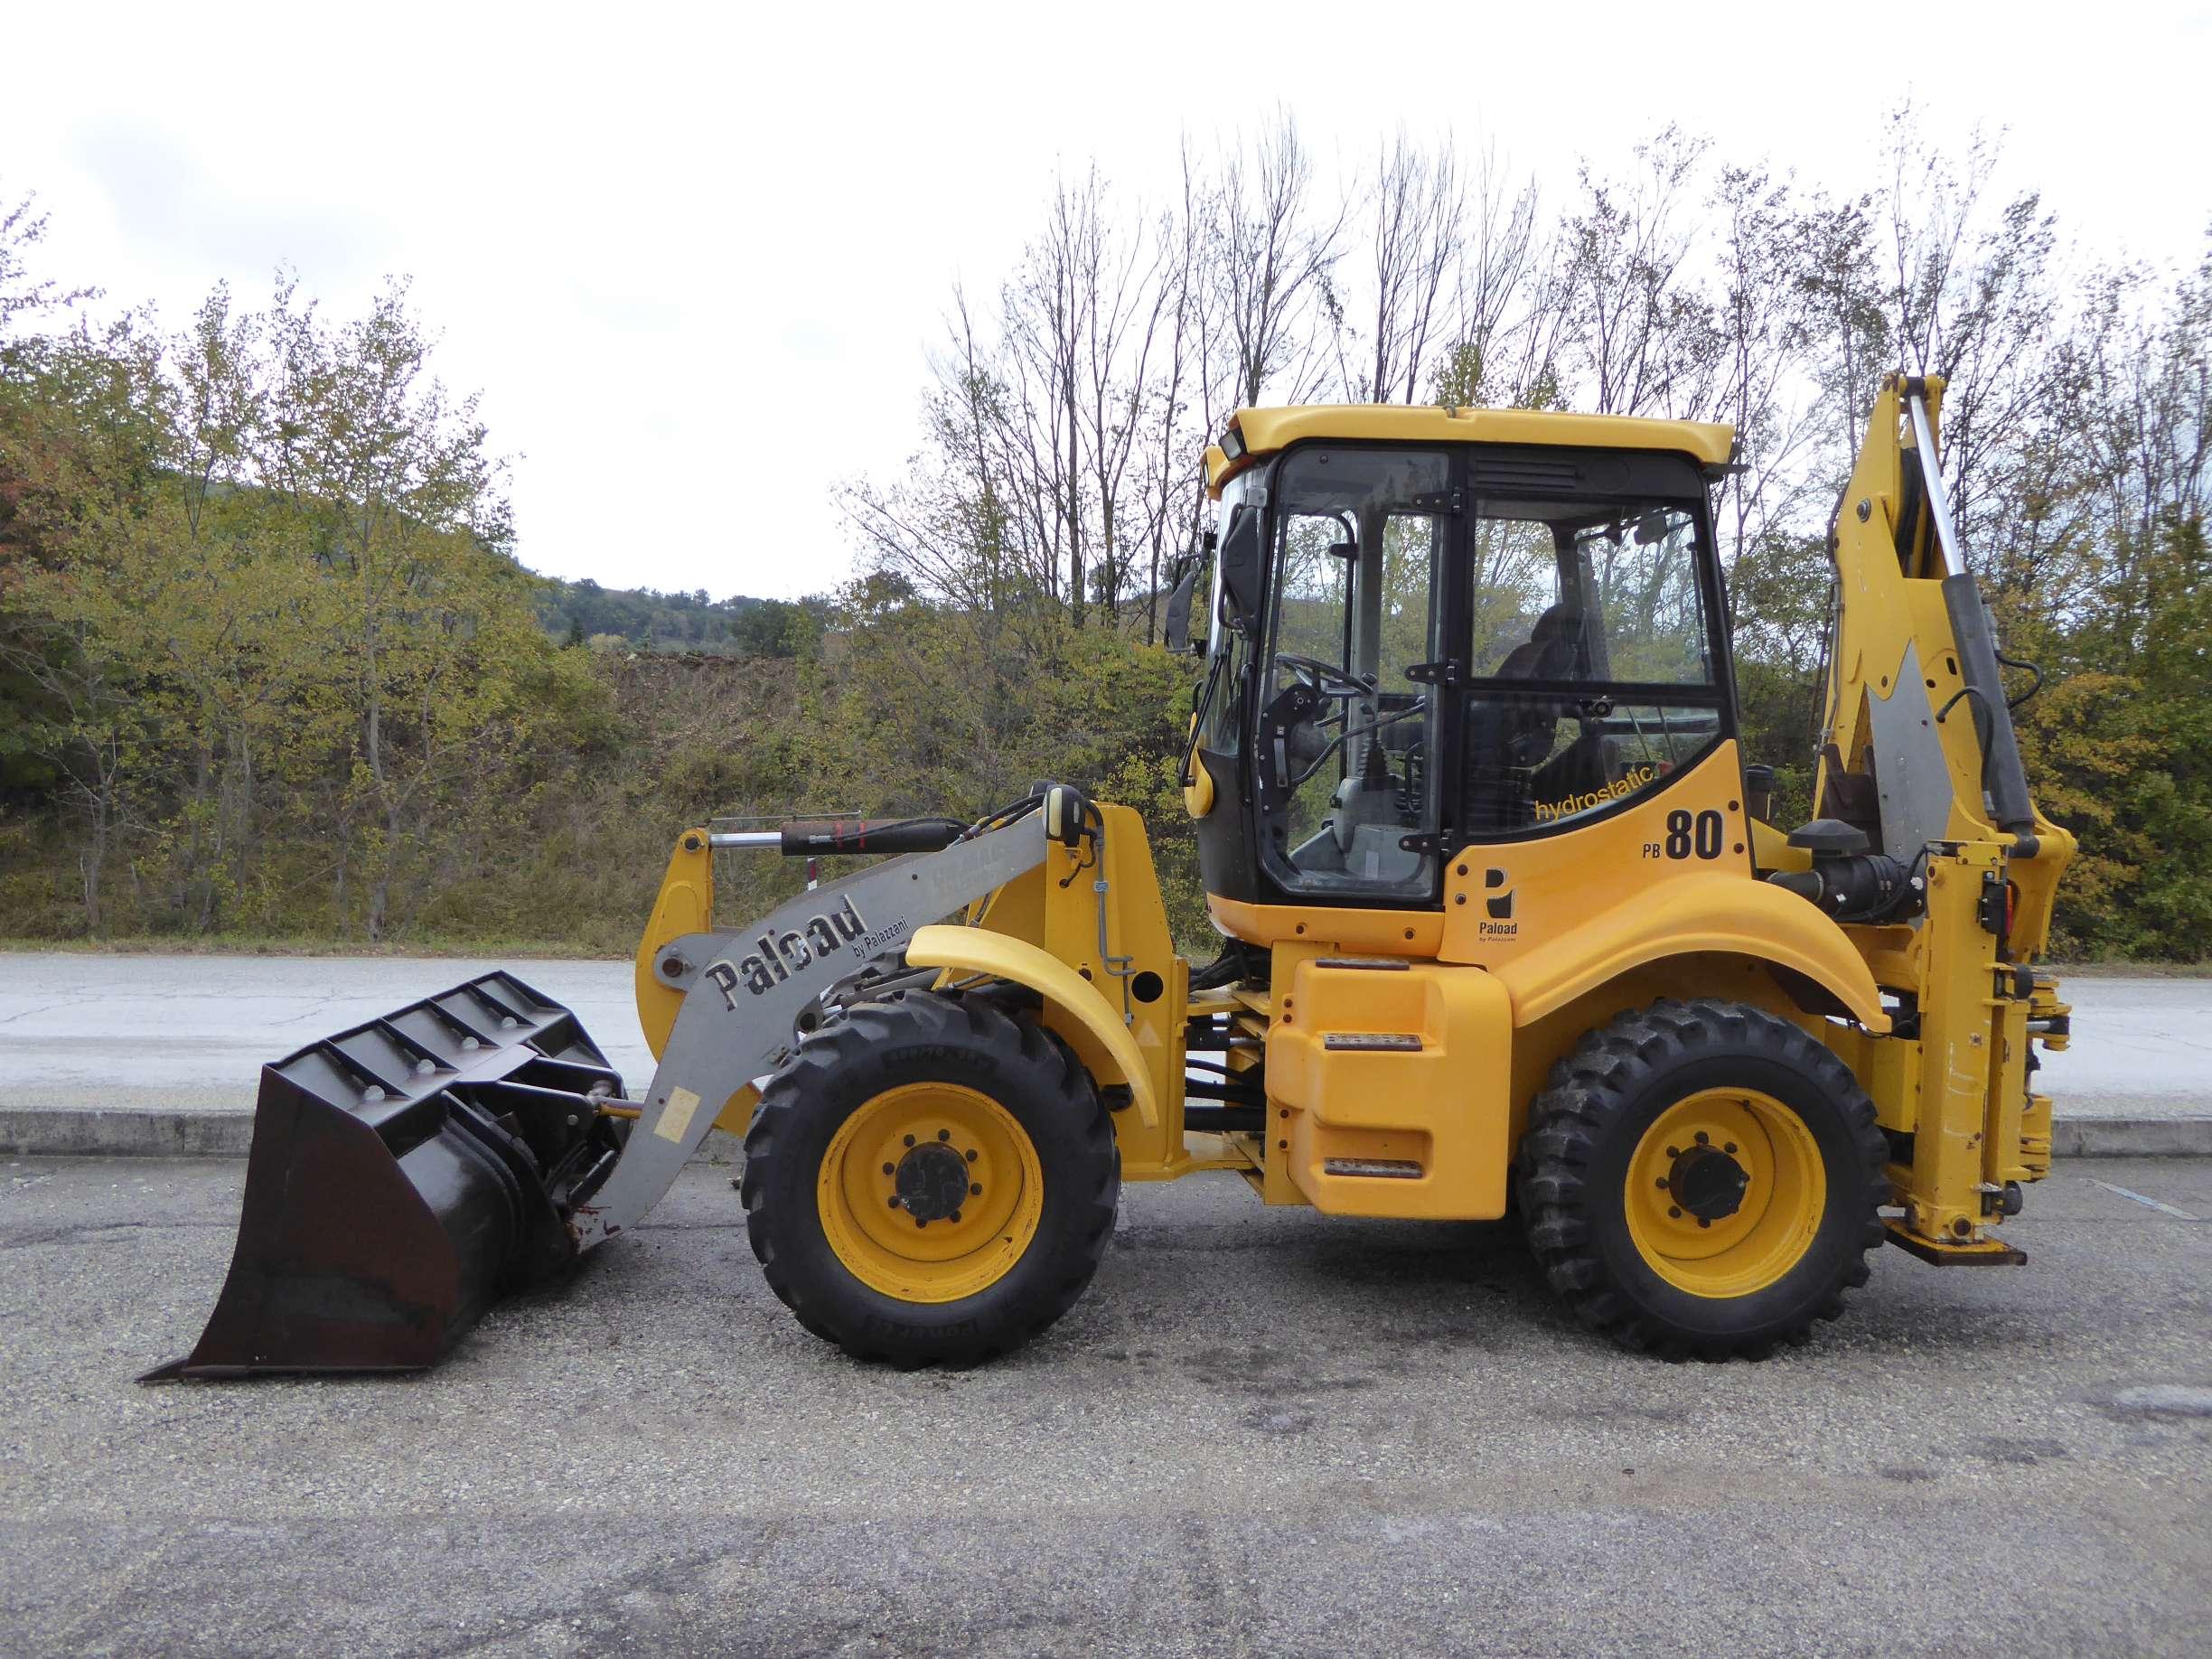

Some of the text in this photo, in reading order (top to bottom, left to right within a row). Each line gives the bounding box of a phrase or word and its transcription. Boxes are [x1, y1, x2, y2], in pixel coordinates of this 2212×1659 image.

[1535, 764, 1654, 822] hydrostatic
[1643, 810, 1723, 860] PB 80
[851, 916, 909, 959] by Palazzani
[1479, 922, 1518, 934] Paload
